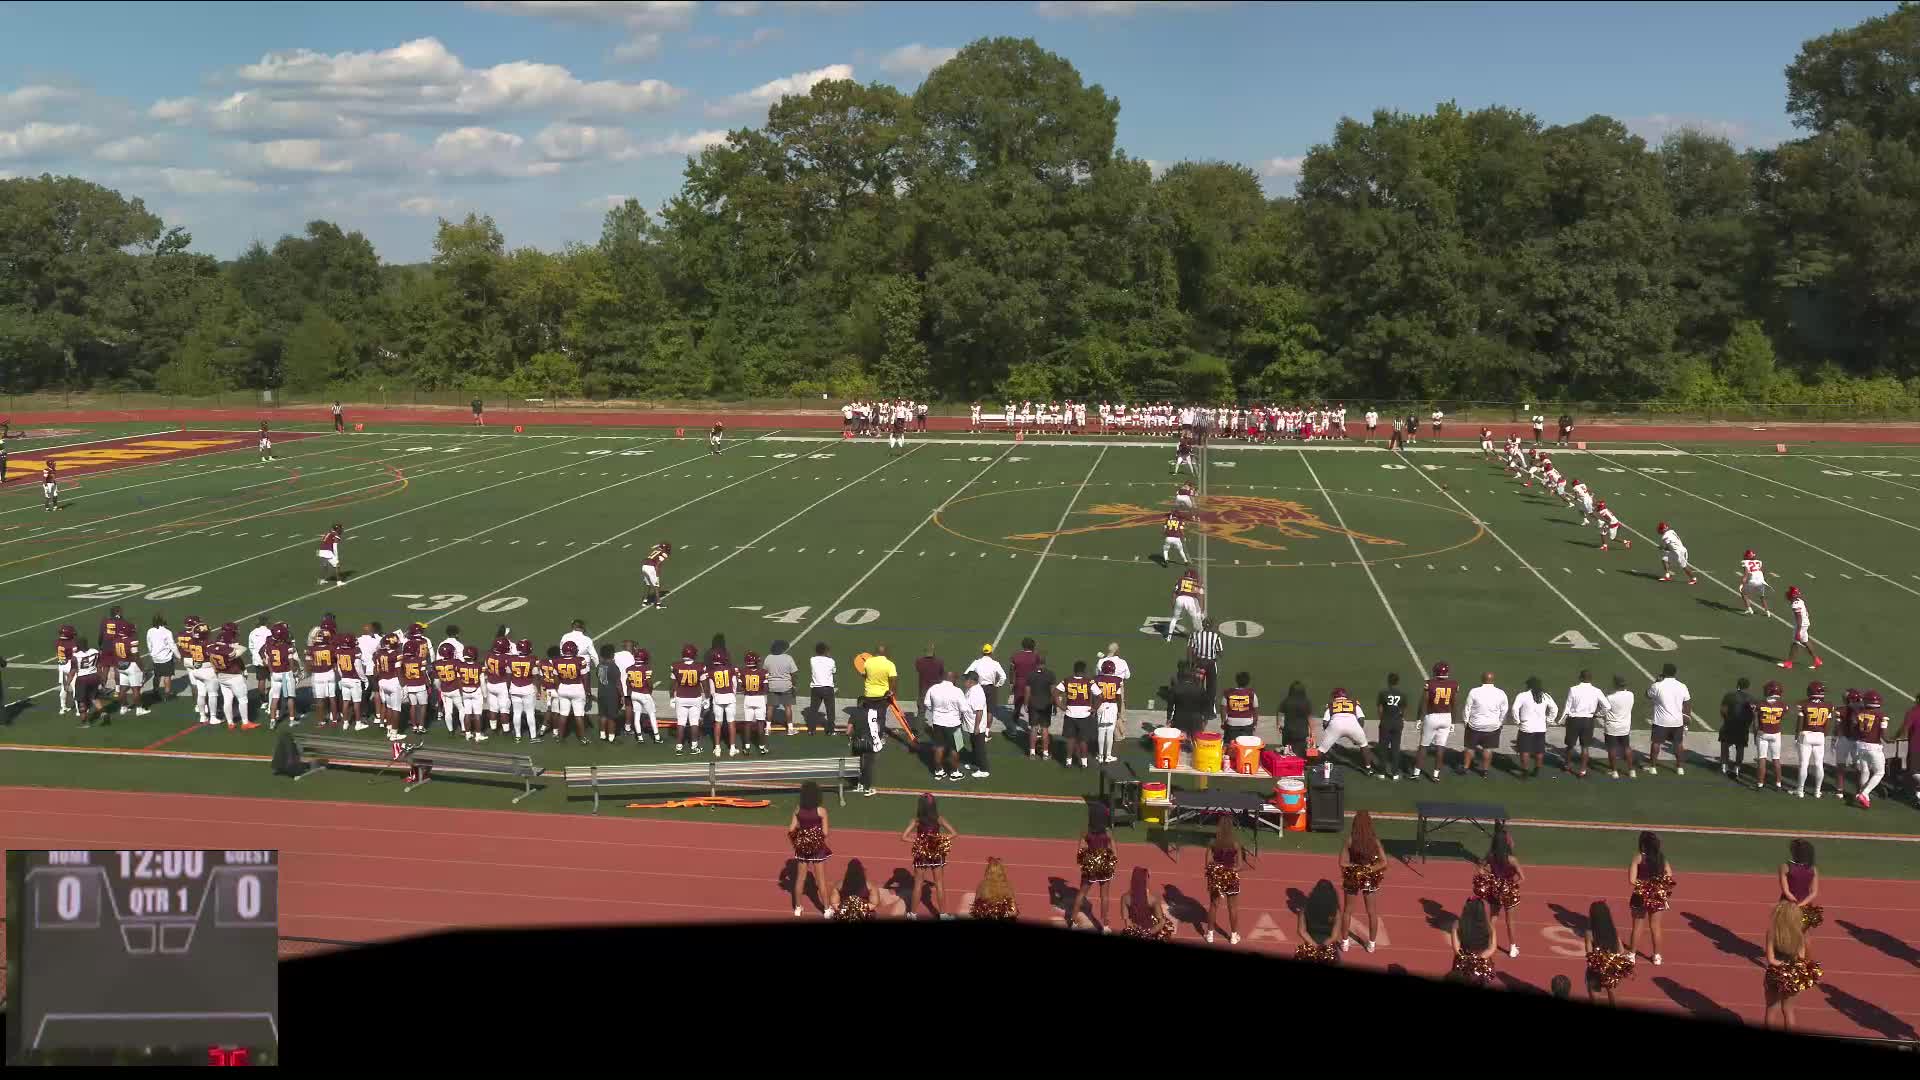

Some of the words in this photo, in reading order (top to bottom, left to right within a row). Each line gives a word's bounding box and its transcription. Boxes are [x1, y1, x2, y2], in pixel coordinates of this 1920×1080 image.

[407, 593, 528, 613] 30
[762, 606, 880, 625] 40
[1548, 630, 1677, 651] 40
[271, 649, 281, 667] 3
[511, 661, 531, 678] 57
[557, 663, 577, 680] 50
[678, 669, 698, 687] 70
[1067, 682, 1089, 700] 54
[1387, 695, 1401, 706] 37
